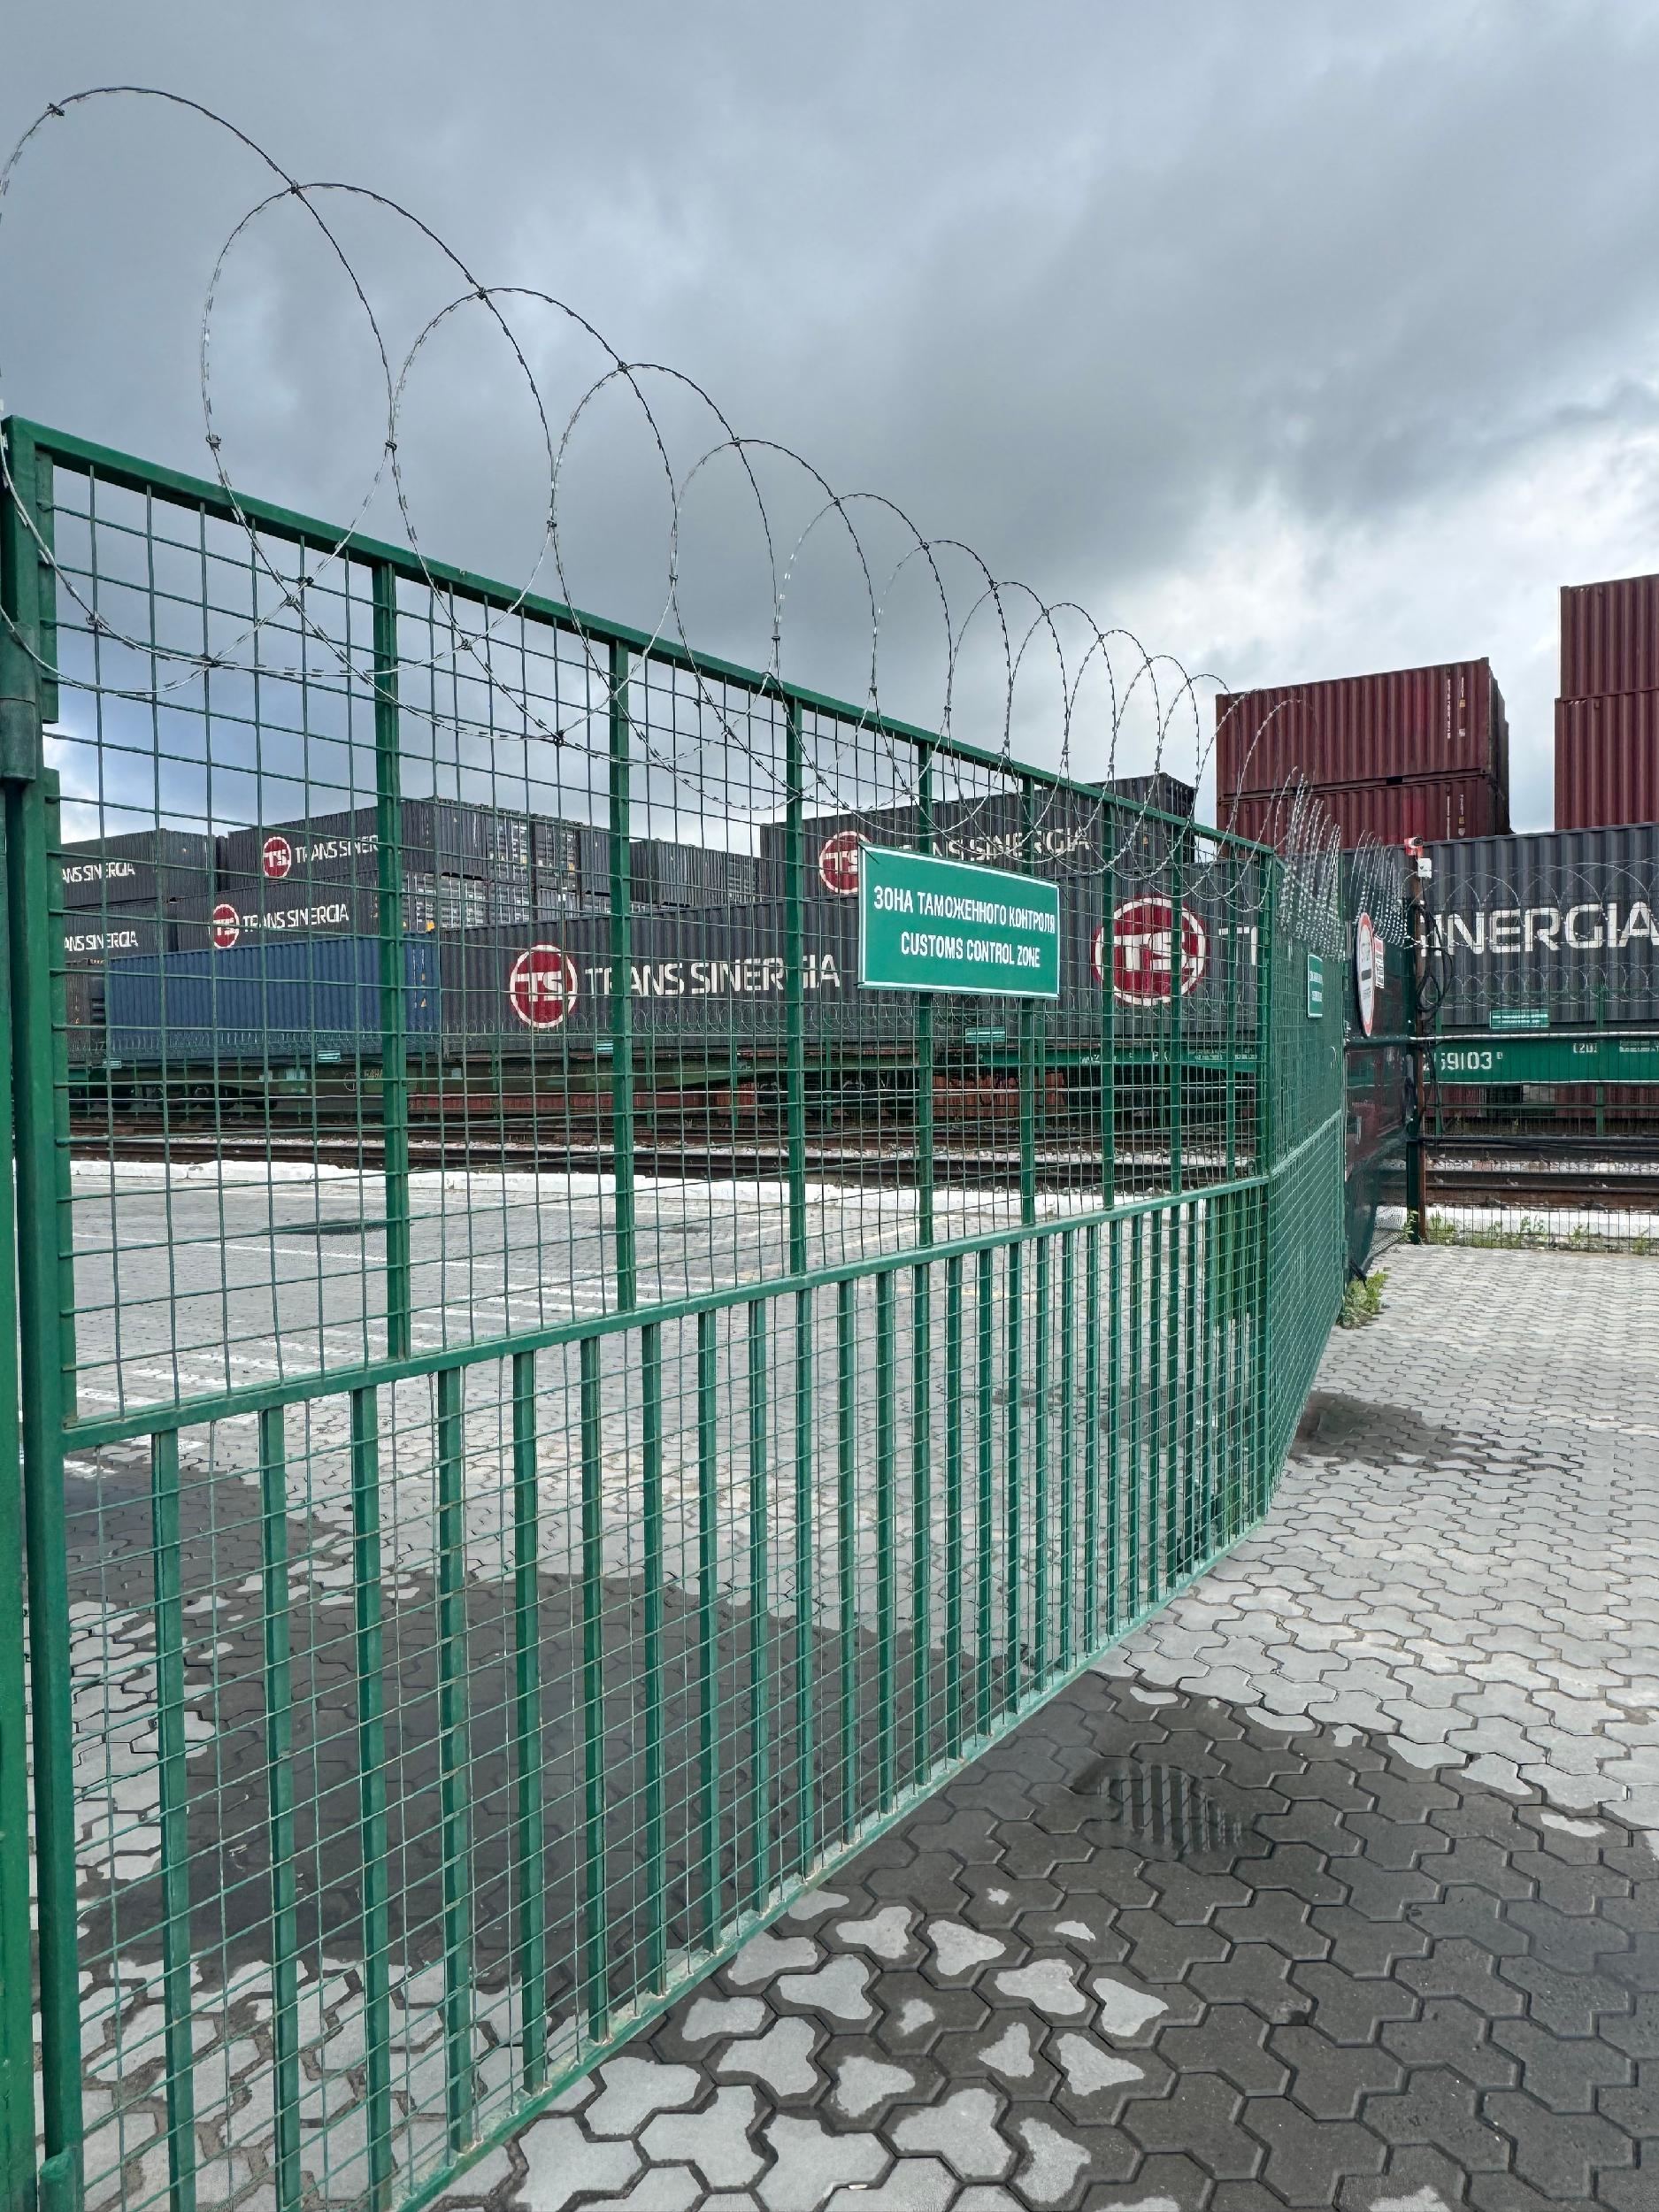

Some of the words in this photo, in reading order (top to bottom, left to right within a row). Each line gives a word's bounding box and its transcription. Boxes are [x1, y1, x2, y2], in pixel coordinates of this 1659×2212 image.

[873, 885, 914, 914] ЗОНА
[917, 891, 1007, 926] ТАМОЖЕННОГО
[1009, 905, 1056, 934] КОНТРОЛЯ
[1420, 901, 1659, 957] INERGIA
[901, 931, 964, 960] CUSTOMS
[966, 939, 1015, 965] CONTROL
[1017, 945, 1041, 968] ZONE
[690, 954, 841, 995] SINERIA
